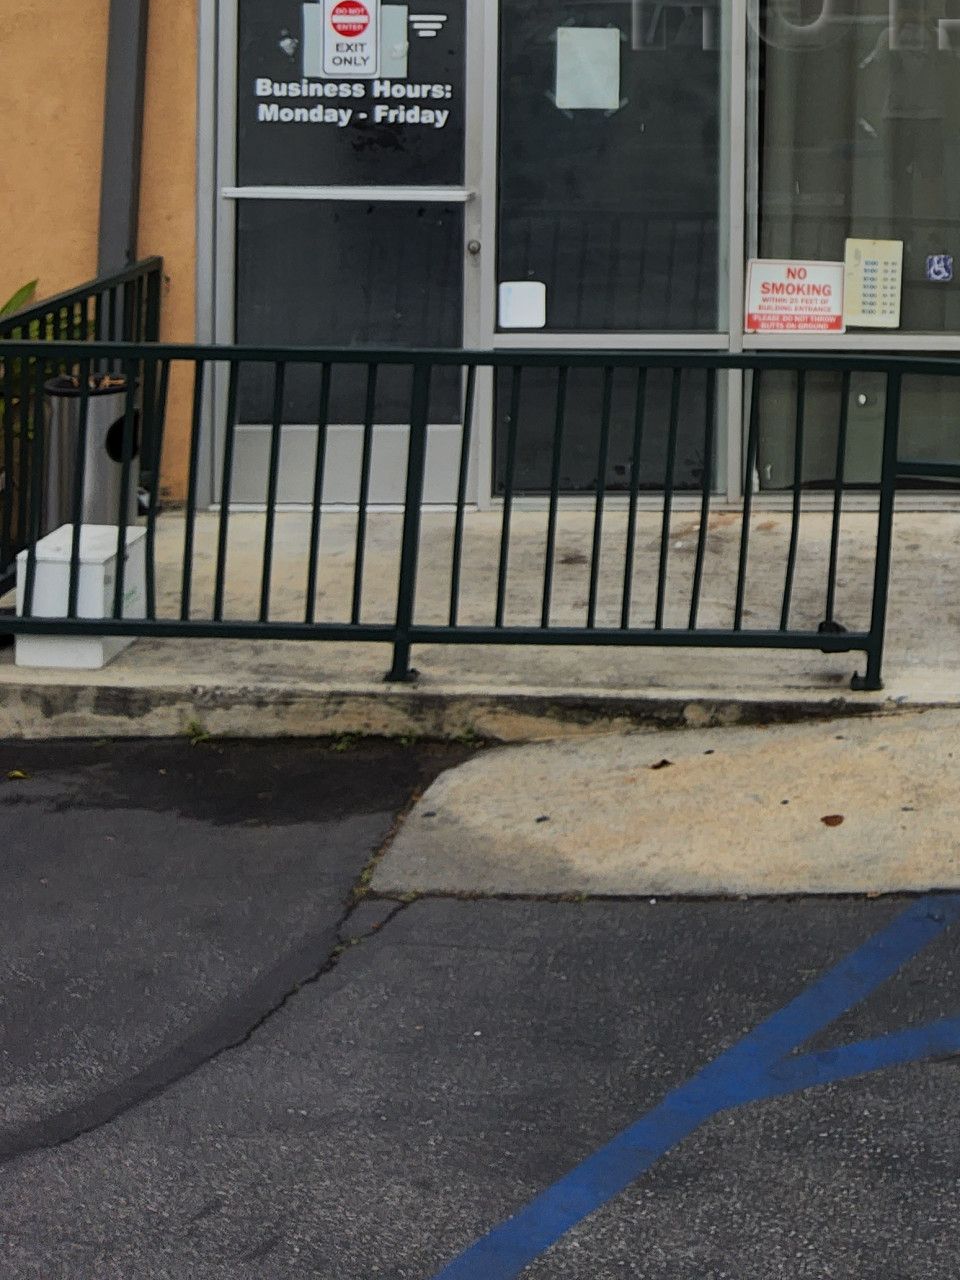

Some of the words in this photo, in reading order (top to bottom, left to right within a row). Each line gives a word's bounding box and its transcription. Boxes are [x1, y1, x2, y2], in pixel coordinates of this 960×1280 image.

[336, 23, 364, 31] ENTER
[336, 43, 367, 53] EXIT
[332, 56, 370, 66] ONLY
[255, 78, 366, 98] Business
[372, 79, 452, 98] Hours:
[258, 104, 352, 127] Monday
[374, 105, 450, 128] Friday
[786, 267, 807, 280] NO
[760, 282, 832, 296] SMOKING
